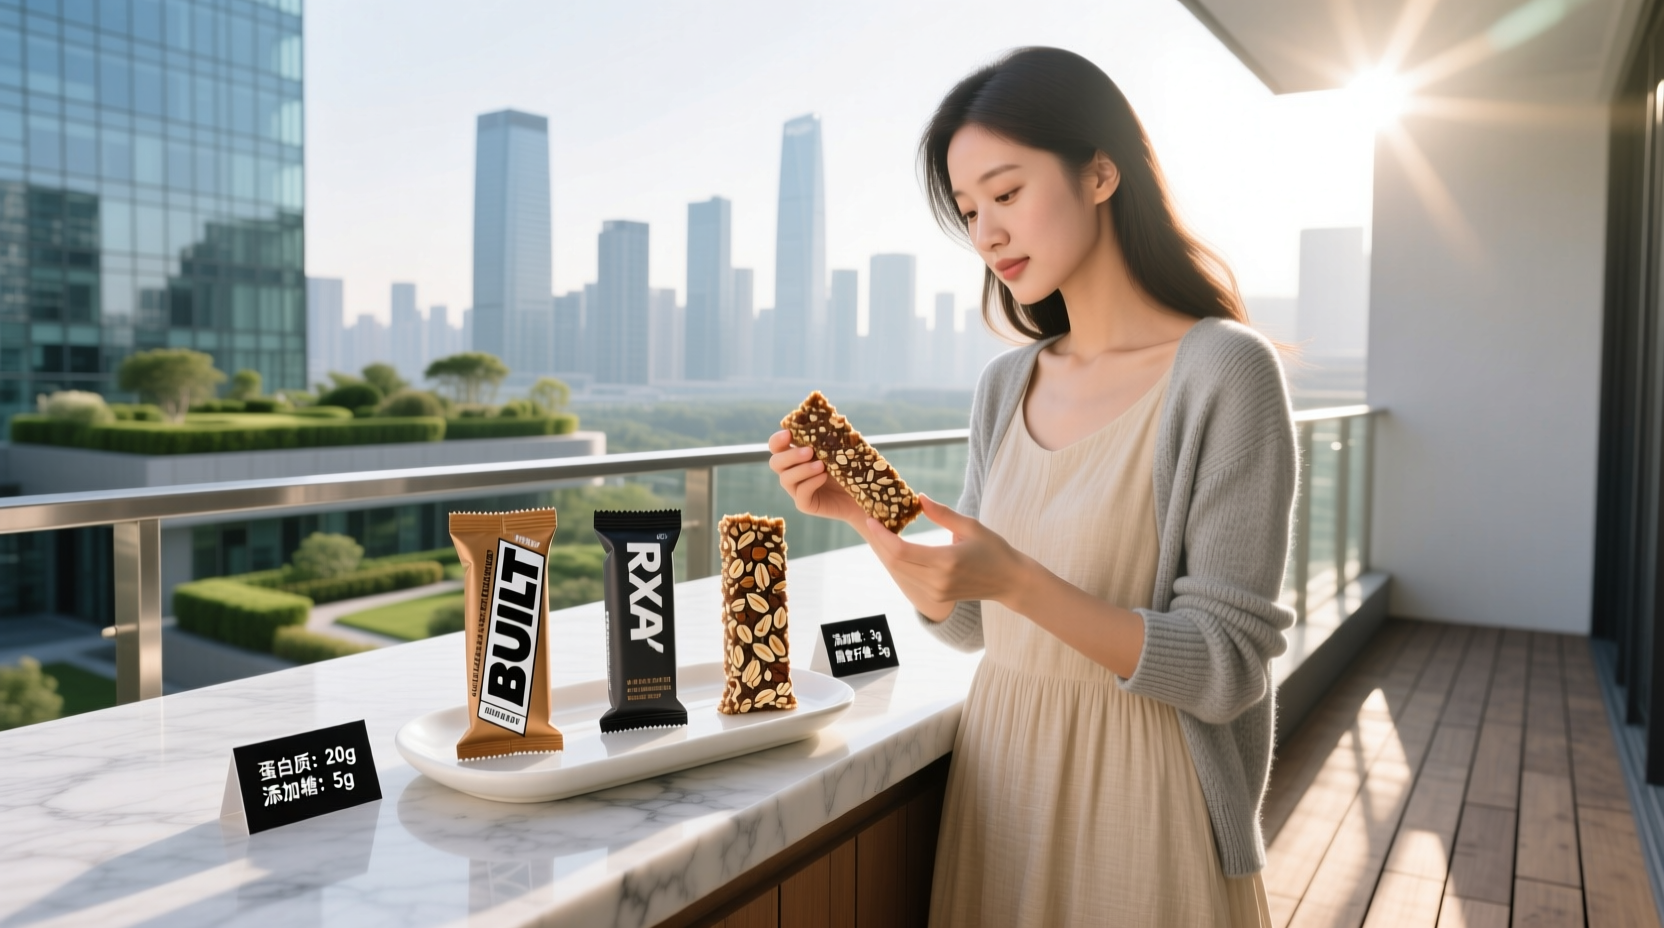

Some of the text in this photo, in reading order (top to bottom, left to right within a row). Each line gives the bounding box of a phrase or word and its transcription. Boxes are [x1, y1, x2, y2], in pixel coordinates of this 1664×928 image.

[488, 547, 539, 707] BUILT
[325, 746, 357, 765] 20g
[333, 771, 355, 791] 5g
